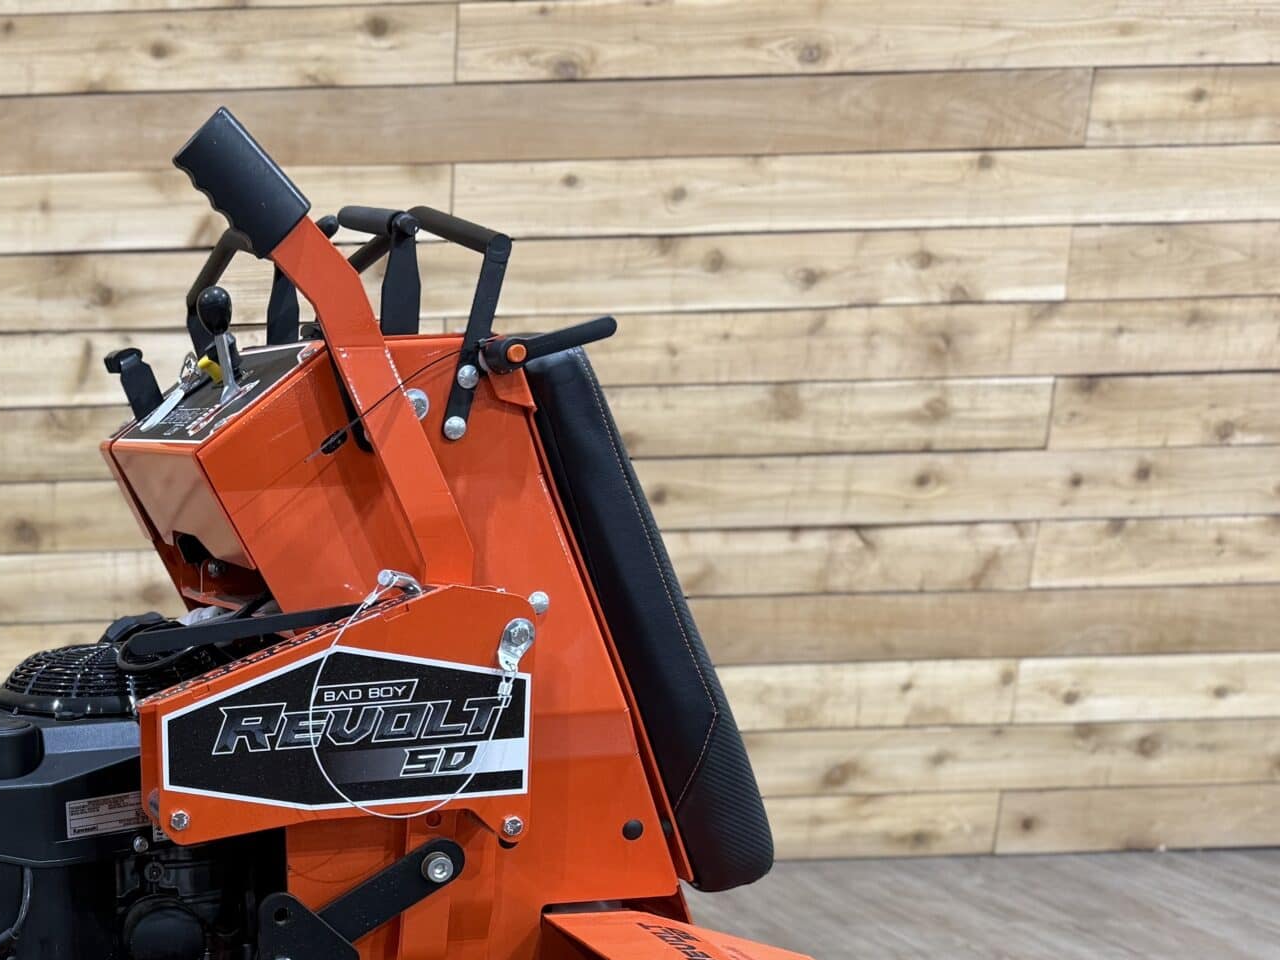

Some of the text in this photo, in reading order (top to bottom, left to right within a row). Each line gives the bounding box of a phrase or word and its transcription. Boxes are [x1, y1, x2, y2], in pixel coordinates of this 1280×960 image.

[323, 685, 407, 702] BAD BOY
[212, 695, 512, 755] REVOLT
[400, 745, 478, 777] SD
